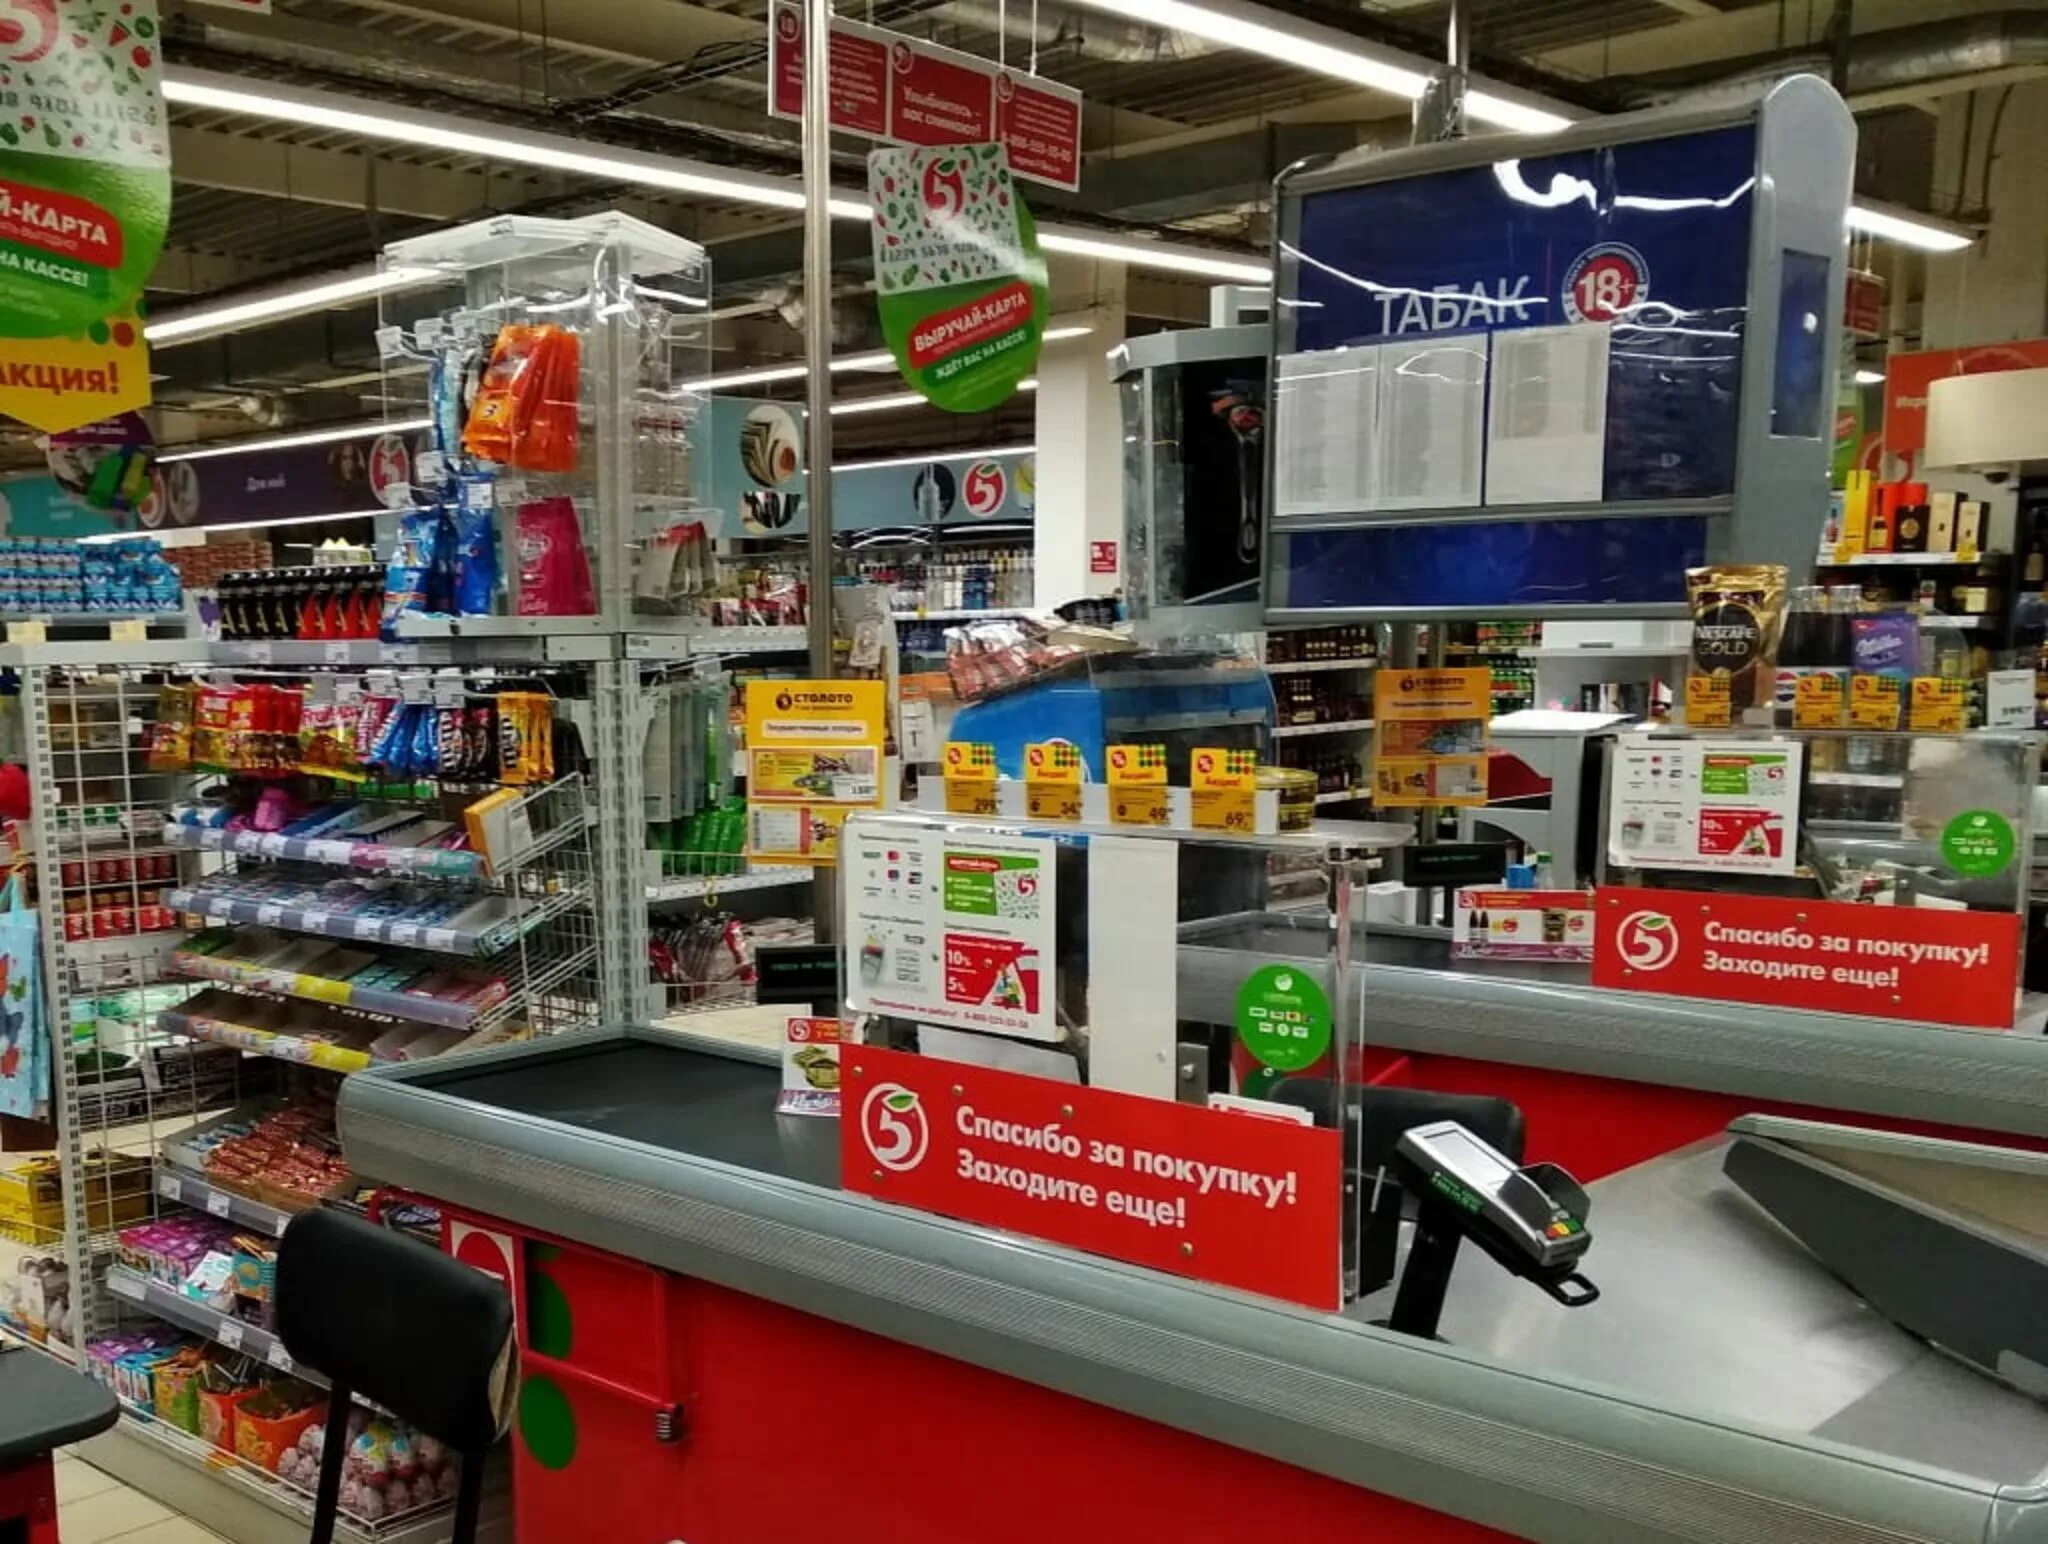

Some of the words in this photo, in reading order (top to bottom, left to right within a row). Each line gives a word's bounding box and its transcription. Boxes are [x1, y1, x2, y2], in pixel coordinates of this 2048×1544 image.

[23, 256, 89, 288] КАССЕ!
[1579, 267, 1634, 312] 18+
[913, 291, 1028, 353] ВЫРУЧАЙ-КАРТА
[1374, 275, 1532, 337] ТАБАК
[1699, 641, 1749, 656] GOLD
[793, 693, 853, 704] СТОЛОТО
[946, 949, 972, 967] 10%
[1703, 921, 1815, 950] Спасибо
[1819, 934, 1850, 954] за
[1856, 940, 1990, 970] покупку!
[1702, 951, 1827, 982] Заходите
[1831, 966, 1899, 990] еще!
[955, 1106, 1082, 1159] Спасибо
[1088, 1139, 1126, 1169] за
[1131, 1149, 1298, 1210] покупку!
[956, 1148, 1099, 1208] Заходите
[1105, 1189, 1187, 1229] еще!
